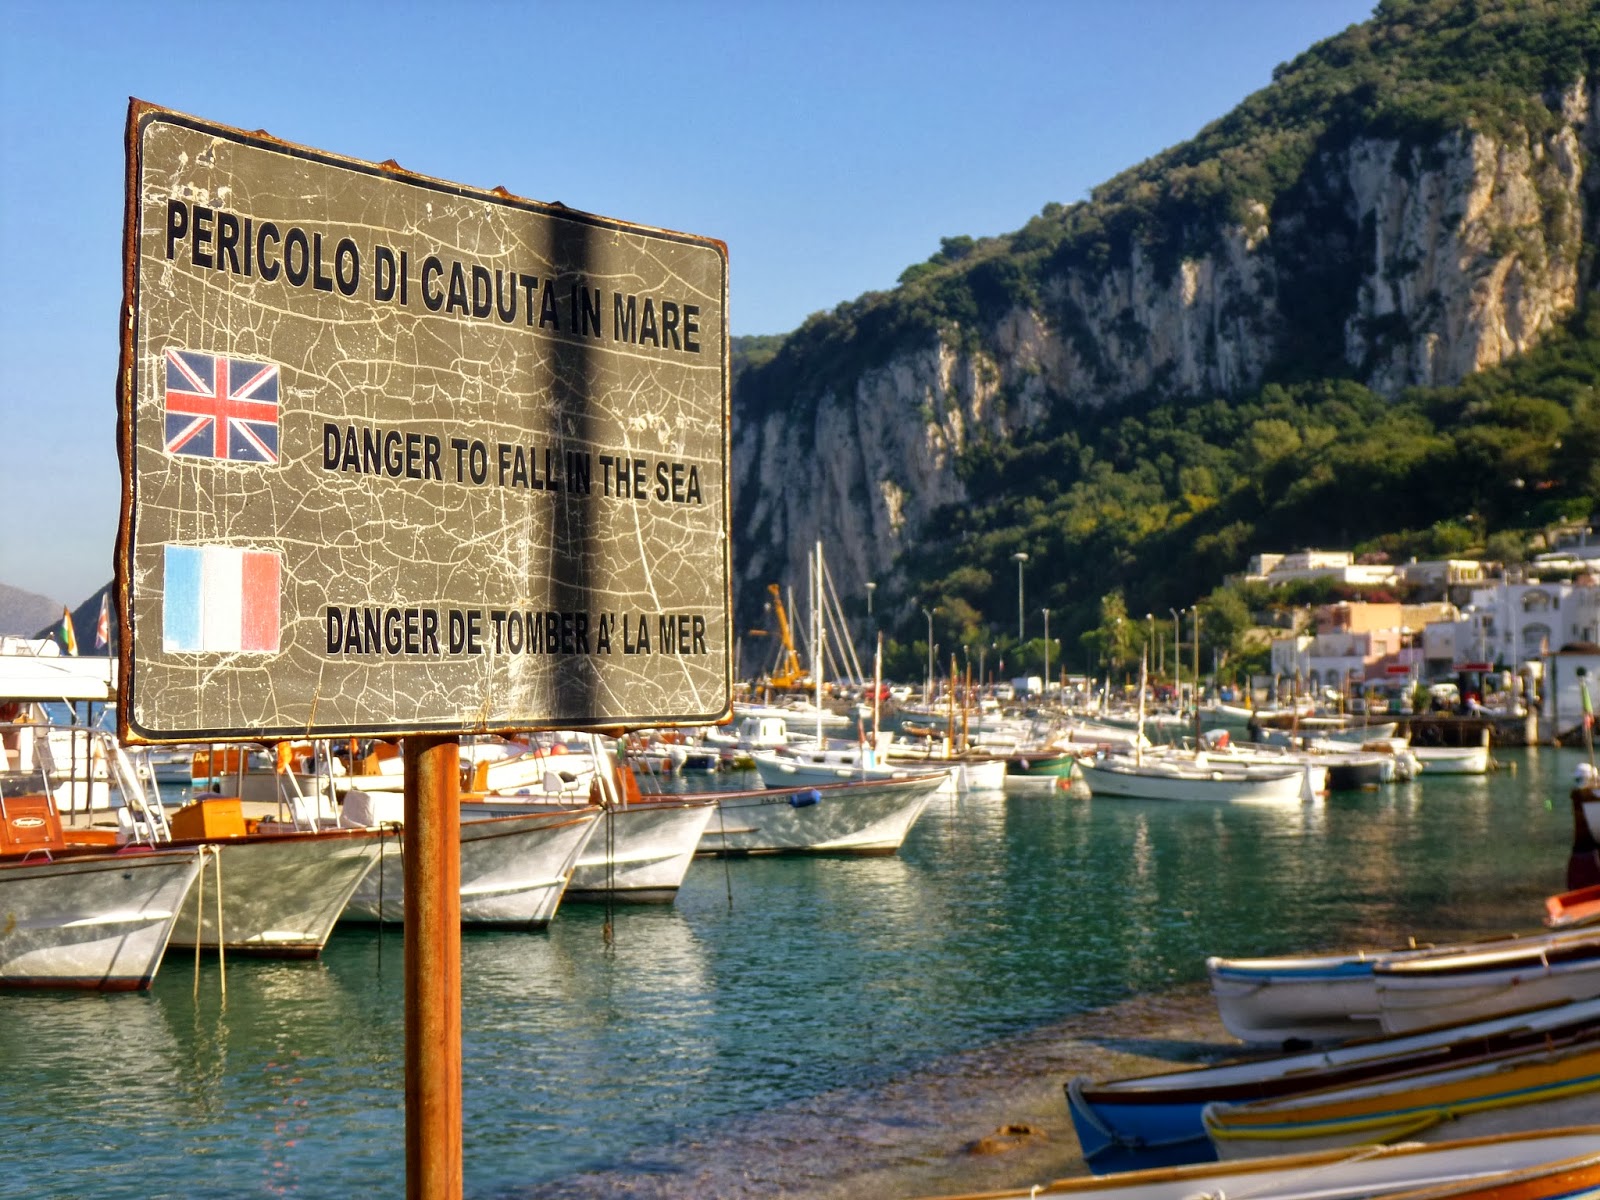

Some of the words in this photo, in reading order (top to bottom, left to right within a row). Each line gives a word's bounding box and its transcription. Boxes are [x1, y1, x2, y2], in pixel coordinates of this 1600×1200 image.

[166, 199, 360, 297] PERICOLO
[374, 244, 408, 306] DI
[421, 256, 560, 332] CADUTA
[570, 283, 601, 339] IN
[613, 292, 701, 353] MARE
[323, 422, 443, 481] DANGER
[451, 438, 488, 485] TO
[498, 443, 559, 492] FALL
[567, 451, 591, 495] IN
[600, 455, 647, 500] THE
[656, 461, 703, 505] SEA
[326, 606, 440, 655] DANGER
[449, 609, 482, 655] DE
[491, 610, 590, 655] TOMBER
[596, 613, 615, 655] A'
[623, 613, 651, 655] LA
[659, 614, 708, 655] MER
